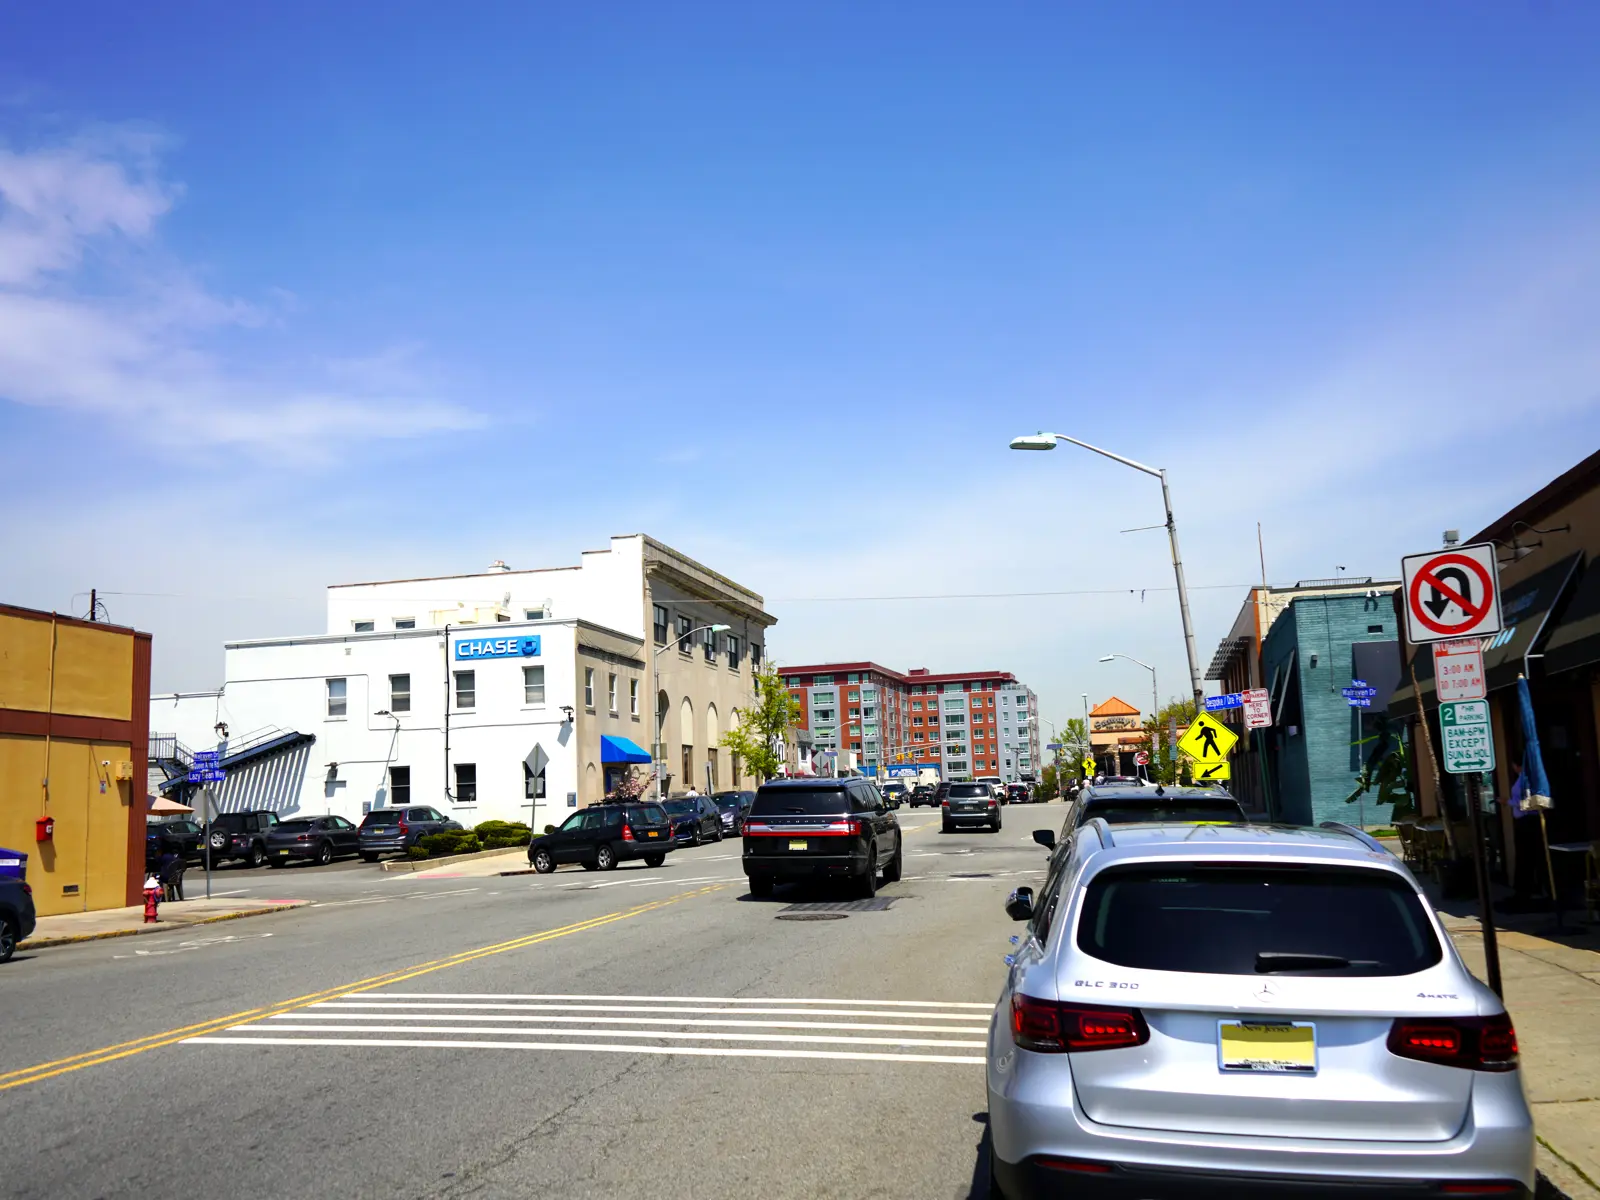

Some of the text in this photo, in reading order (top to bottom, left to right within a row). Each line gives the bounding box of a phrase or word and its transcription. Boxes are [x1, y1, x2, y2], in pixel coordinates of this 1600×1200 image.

[458, 639, 519, 657] CHASE
[1443, 664, 1462, 675] 3:00
[1369, 688, 1377, 696] Dr
[1443, 708, 1454, 721] 2
[1459, 713, 1484, 721] PARKING
[1447, 727, 1485, 738] 8AM-6PM
[1448, 737, 1486, 749] EXCEPT
[1448, 749, 1490, 760] SUN & HOL
[189, 772, 201, 782] Lazy
[214, 770, 226, 781] Way
[1074, 980, 1140, 990] GLC 300
[1416, 992, 1459, 1000] 4MATIC
